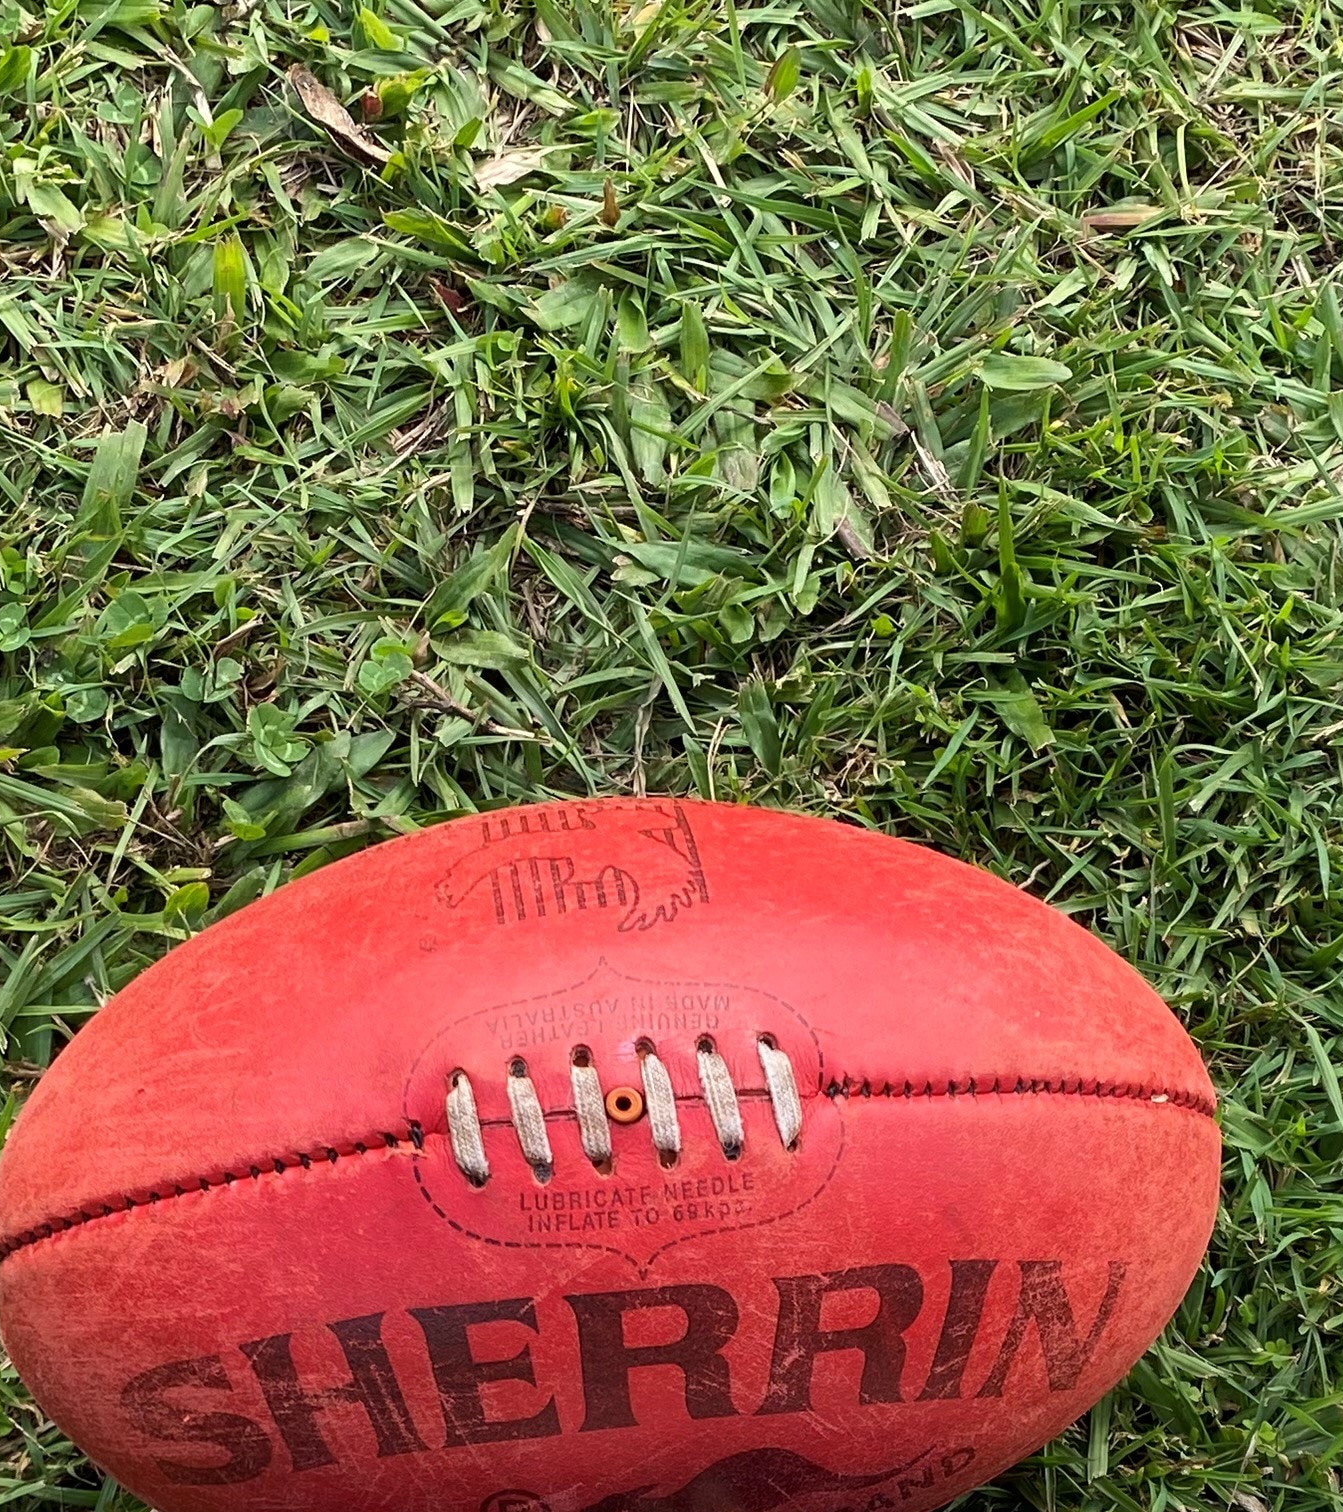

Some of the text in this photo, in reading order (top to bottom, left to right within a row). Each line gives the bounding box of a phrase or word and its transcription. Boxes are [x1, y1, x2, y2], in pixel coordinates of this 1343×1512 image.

[484, 992, 731, 1035] MADE IN AUSTRALIA
[499, 1013, 720, 1050] GENUINE LEATHER
[519, 1171, 755, 1212] LUBRICATE NEEDLE
[527, 1209, 620, 1234] INFLATE
[630, 1206, 661, 1227] TO
[121, 1259, 1127, 1487] SHERRIN
